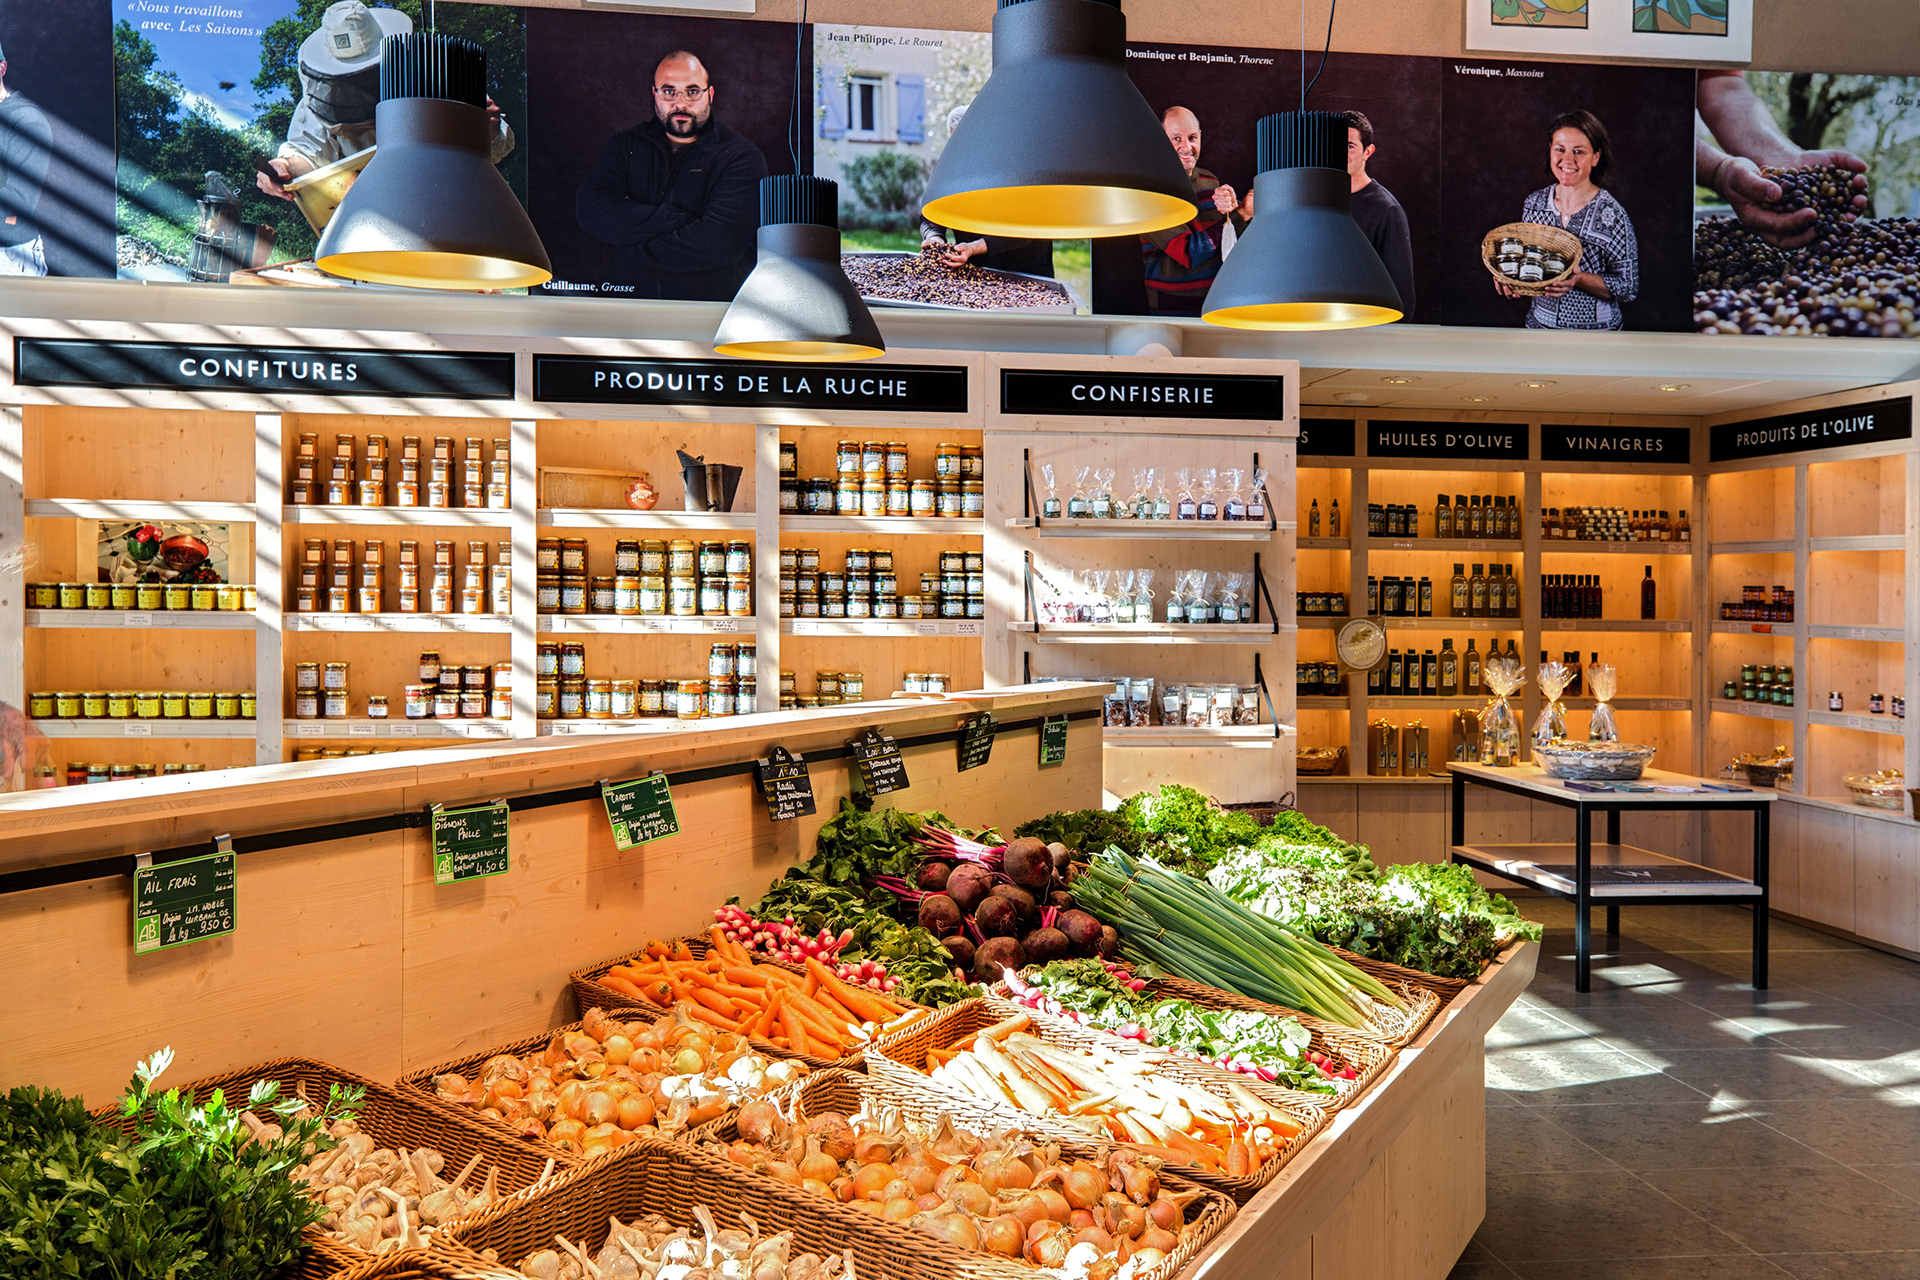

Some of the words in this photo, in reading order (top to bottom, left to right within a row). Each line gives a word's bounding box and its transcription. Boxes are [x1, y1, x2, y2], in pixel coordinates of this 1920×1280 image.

[174, 4, 244, 18] travaillons
[141, 20, 174, 32] avec,
[178, 20, 202, 32] Les
[828, 32, 850, 42] Jean
[854, 34, 896, 46] Philippe,
[898, 36, 910, 45] Le
[912, 37, 944, 47] Rouret
[1125, 48, 1176, 62] Dominique
[1178, 52, 1187, 61] et
[1189, 52, 1238, 64] Benjamin,
[1238, 54, 1275, 65] Thorenc
[1454, 65, 1503, 78] Véronique,
[1505, 68, 1544, 78] Massoins
[542, 280, 598, 292] Guillaume,
[600, 282, 635, 292] Grasse
[179, 358, 358, 382] CONFITURES
[594, 370, 724, 392] PRODUITS
[738, 374, 769, 393] DE
[782, 376, 812, 394] LA
[825, 378, 908, 398] RUCHE
[1071, 384, 1214, 404] CONFISERIE
[1737, 427, 1796, 447] PRODUITS
[1801, 424, 1818, 439] DE
[1823, 414, 1875, 437] L'OLIVE
[1379, 432, 1437, 447] HUILES
[1446, 434, 1513, 449] D'OLIVE
[1566, 436, 1664, 452] VINAIGRES
[670, 822, 676, 832] €
[438, 860, 451, 875] AB
[499, 858, 506, 870] €
[144, 881, 162, 895] AIL
[168, 874, 197, 891] FRAIS
[202, 899, 225, 912] NOBLE
[139, 923, 157, 942] AB
[199, 920, 220, 934] 9,50
[222, 916, 231, 929] €
